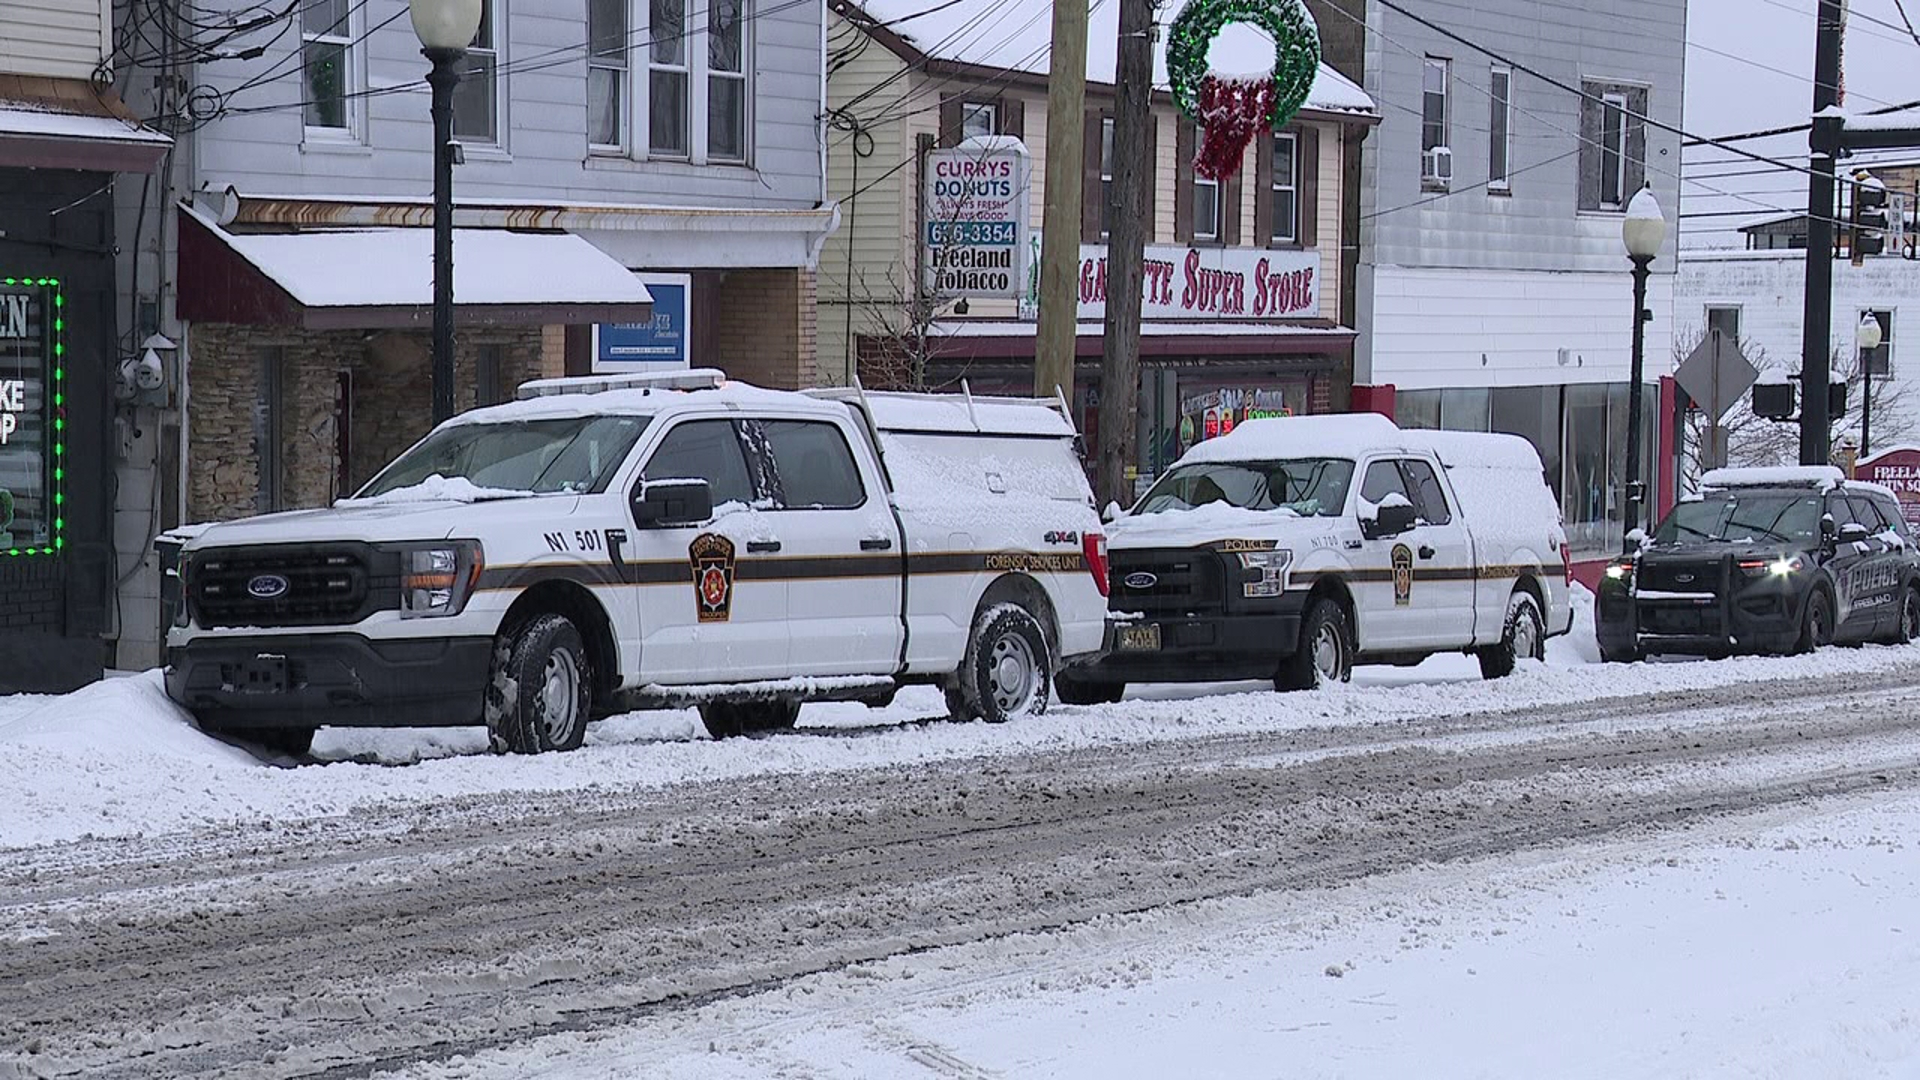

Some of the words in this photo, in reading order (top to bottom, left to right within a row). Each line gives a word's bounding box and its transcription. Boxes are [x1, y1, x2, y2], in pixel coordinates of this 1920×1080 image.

[935, 181, 1010, 196] DONUTS
[932, 248, 1011, 268] Freeland
[575, 529, 602, 551] 501
[1224, 540, 1267, 550] POLICE
[986, 555, 1028, 569] FORENSIC
[1061, 555, 1080, 569] UNIT
[1851, 563, 1898, 595] POLICE
